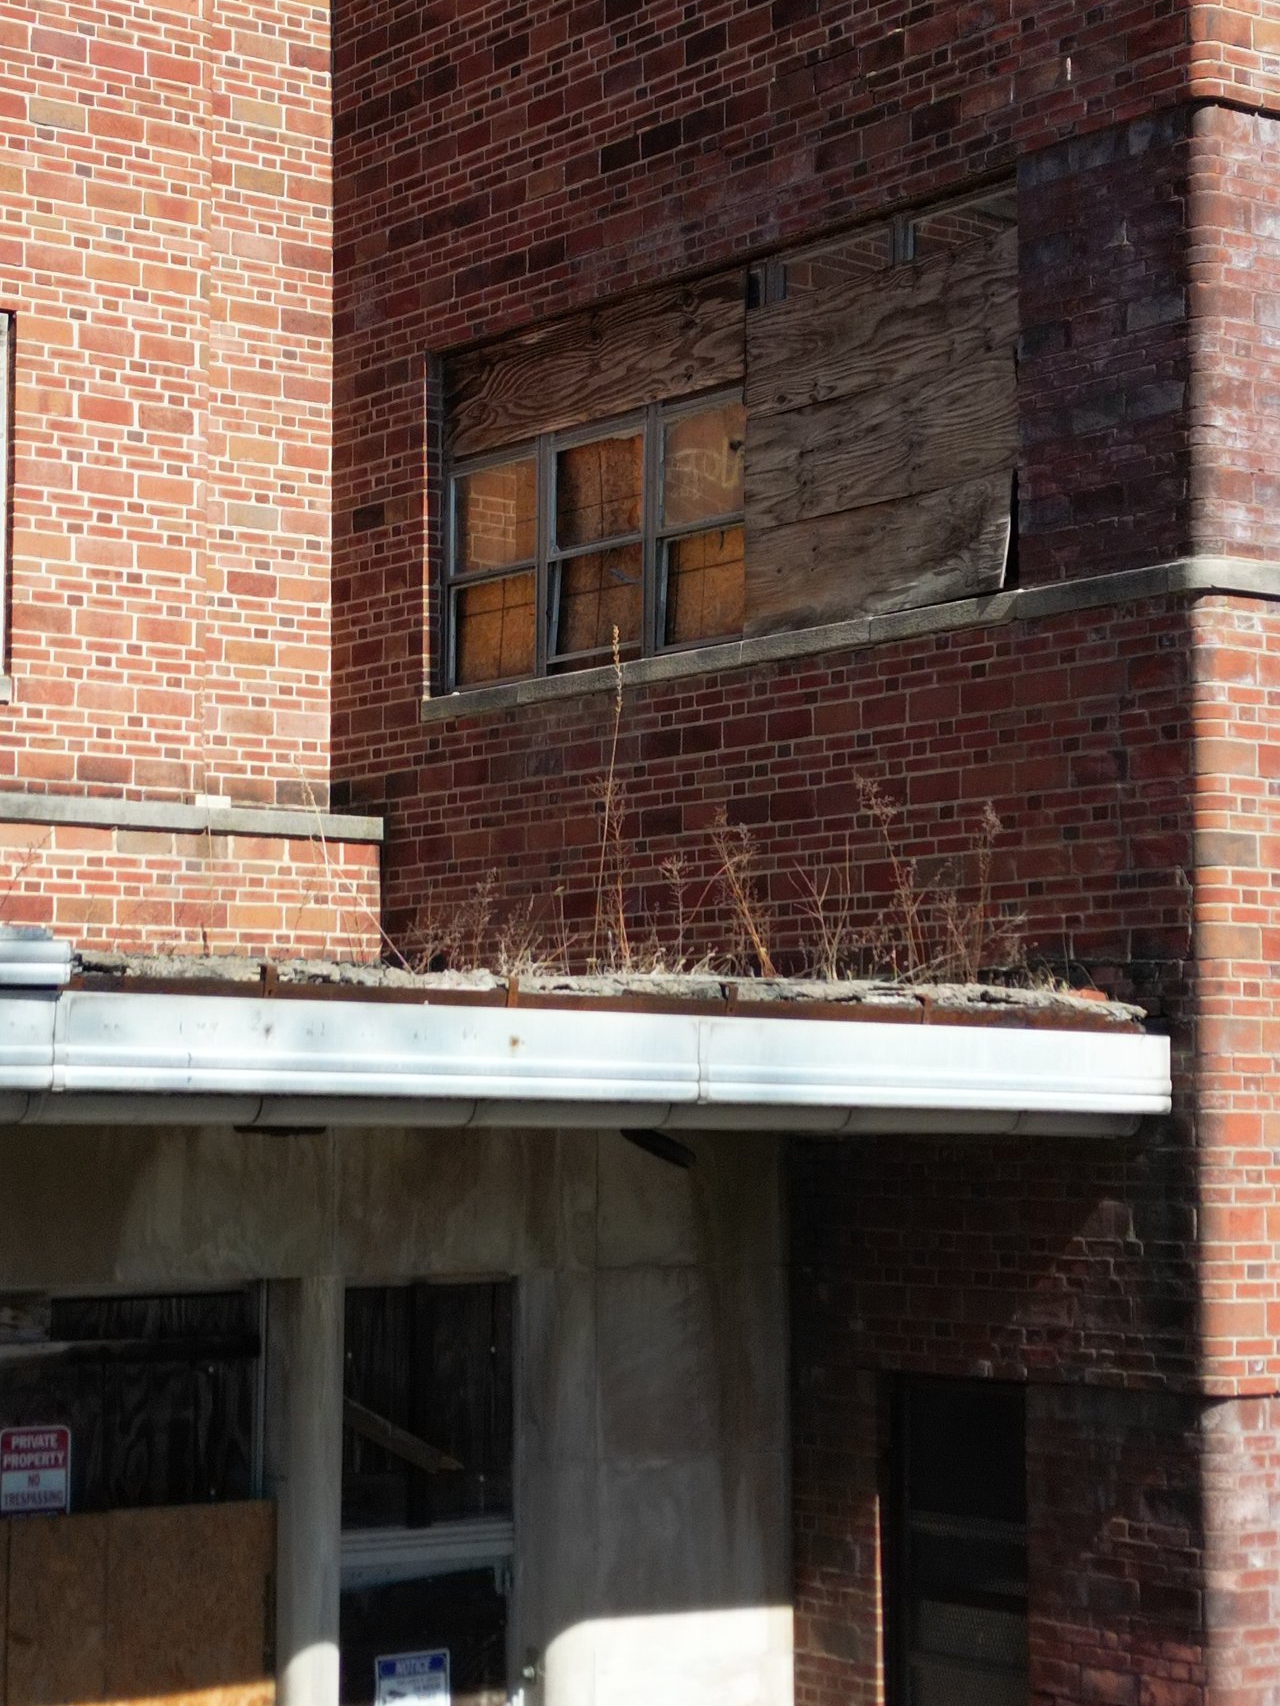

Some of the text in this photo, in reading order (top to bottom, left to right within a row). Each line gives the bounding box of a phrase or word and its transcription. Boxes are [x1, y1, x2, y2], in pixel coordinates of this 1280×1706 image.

[11, 1432, 58, 1450] PRIVATE
[2, 1451, 65, 1469] PROPERTY
[27, 1474, 40, 1488] NO
